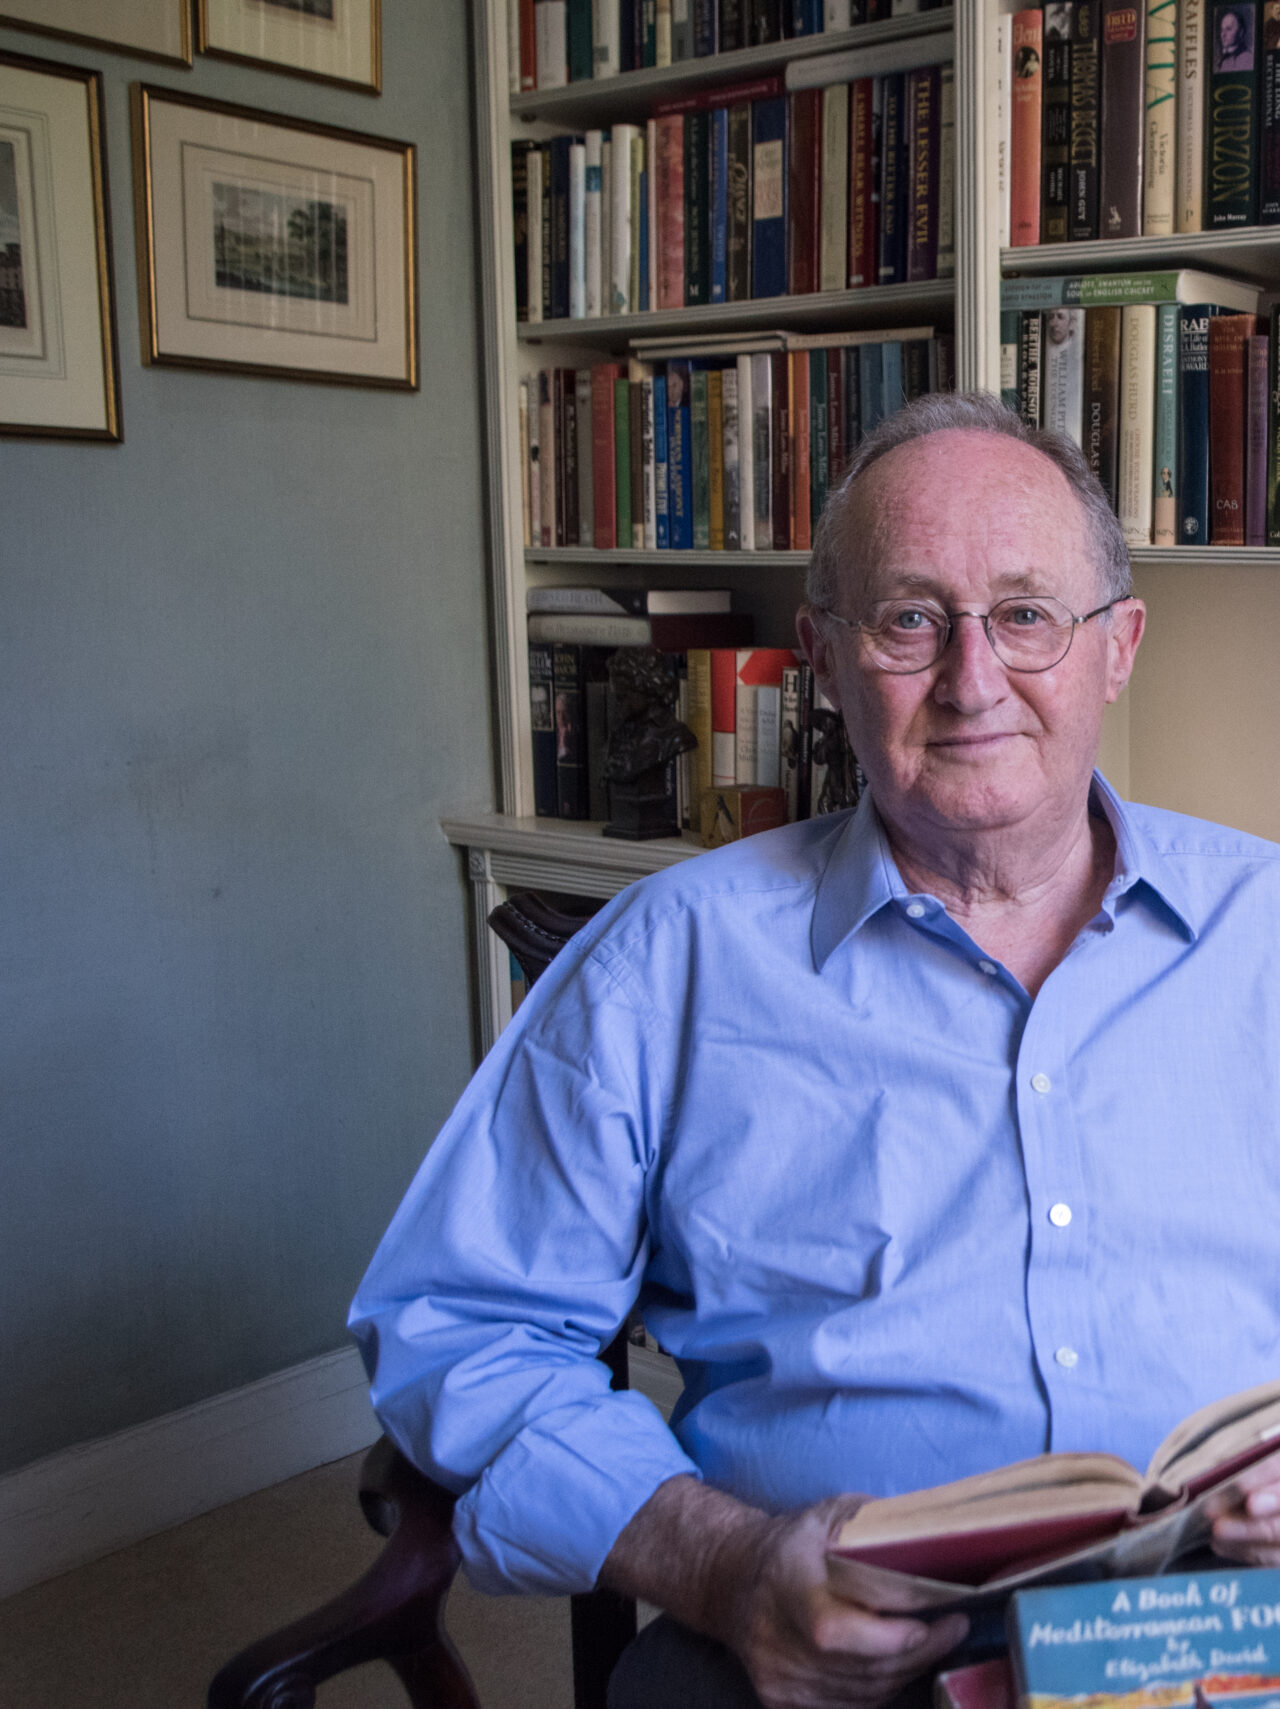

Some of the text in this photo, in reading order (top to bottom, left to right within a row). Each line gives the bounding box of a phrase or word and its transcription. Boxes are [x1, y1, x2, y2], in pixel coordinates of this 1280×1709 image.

[1147, 0, 1176, 111] VITA
[1071, 38, 1096, 167] THOMAS BECKET
[1265, 54, 1273, 129] RECESSIONAL
[888, 120, 896, 144] THE
[916, 79, 931, 243] THE LESSER EVIL
[1148, 121, 1158, 189] Glendinning
[1159, 133, 1168, 175] Victoria
[1213, 84, 1253, 202] CURZON
[1077, 171, 1086, 220] JOHN GUY
[1129, 318, 1138, 420] DOUGLAS HURD
[1162, 314, 1174, 395] DISRAELI
[1090, 402, 1101, 467] DOUGLAS
[1112, 1580, 1239, 1612] A Book Of
[1029, 1616, 1222, 1648] Mediterranean
[1105, 1644, 1268, 1678] Elizabeth David
[1166, 1637, 1191, 1655] by
